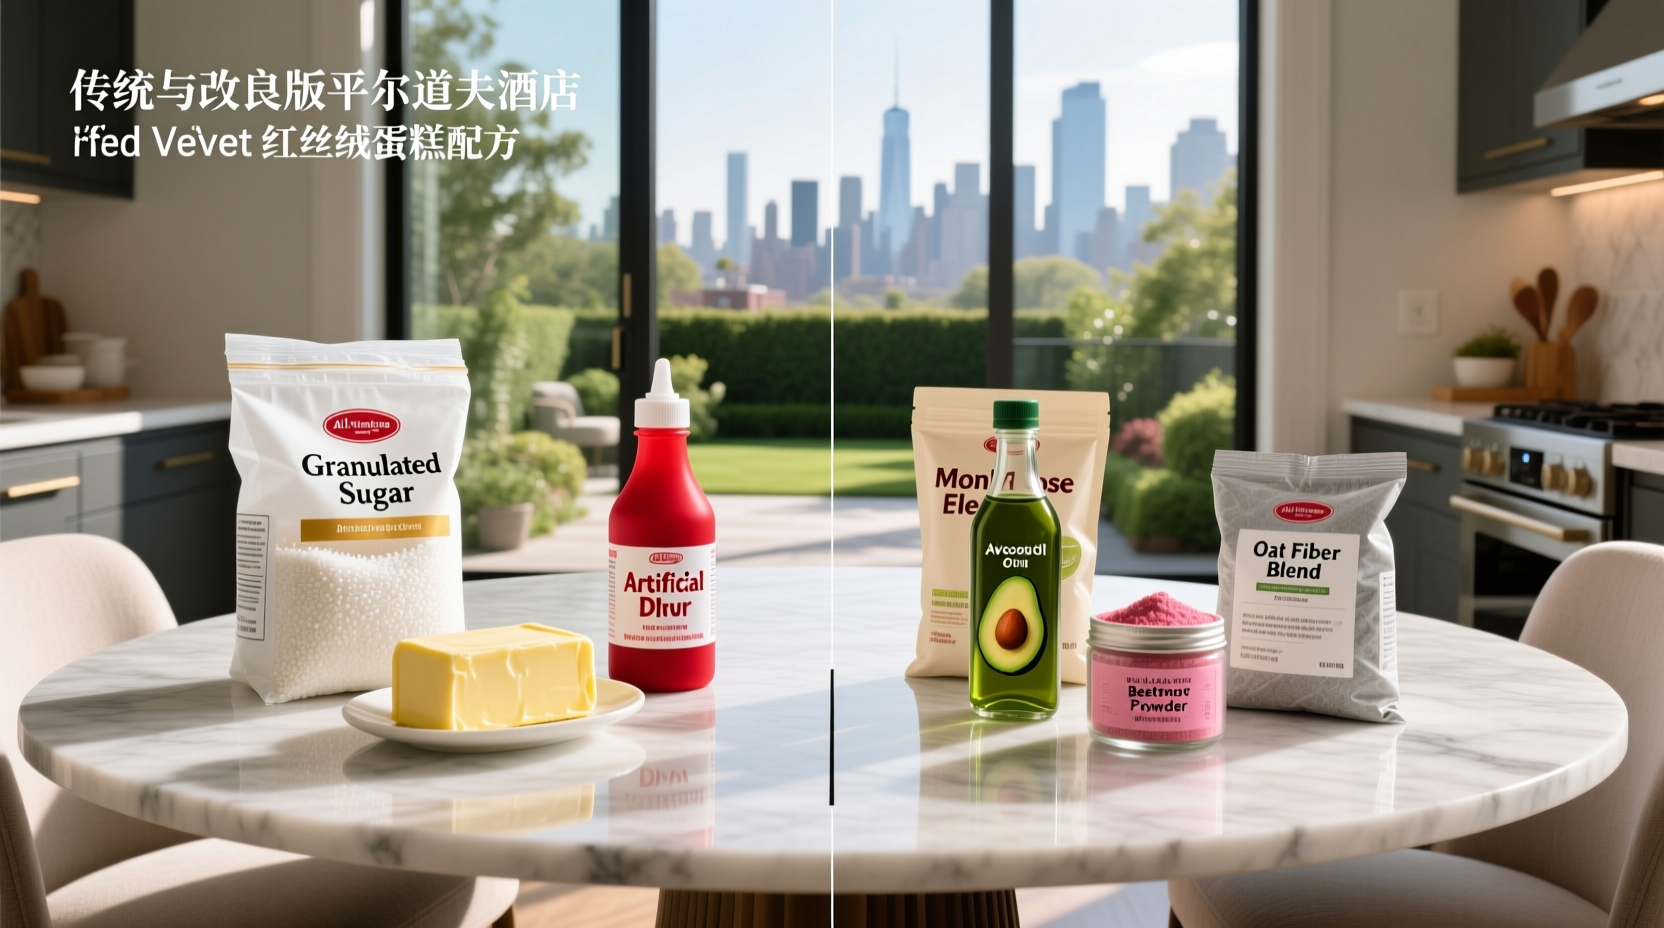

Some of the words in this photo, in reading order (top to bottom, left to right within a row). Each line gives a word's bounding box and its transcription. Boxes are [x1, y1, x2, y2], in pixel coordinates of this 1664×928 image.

[301, 452, 442, 477] Granulated
[339, 481, 414, 512] Sugar
[1253, 540, 1286, 559] Oat
[1291, 542, 1341, 561] Fiber
[623, 570, 704, 593] Artificial
[1266, 561, 1322, 580] Blend
